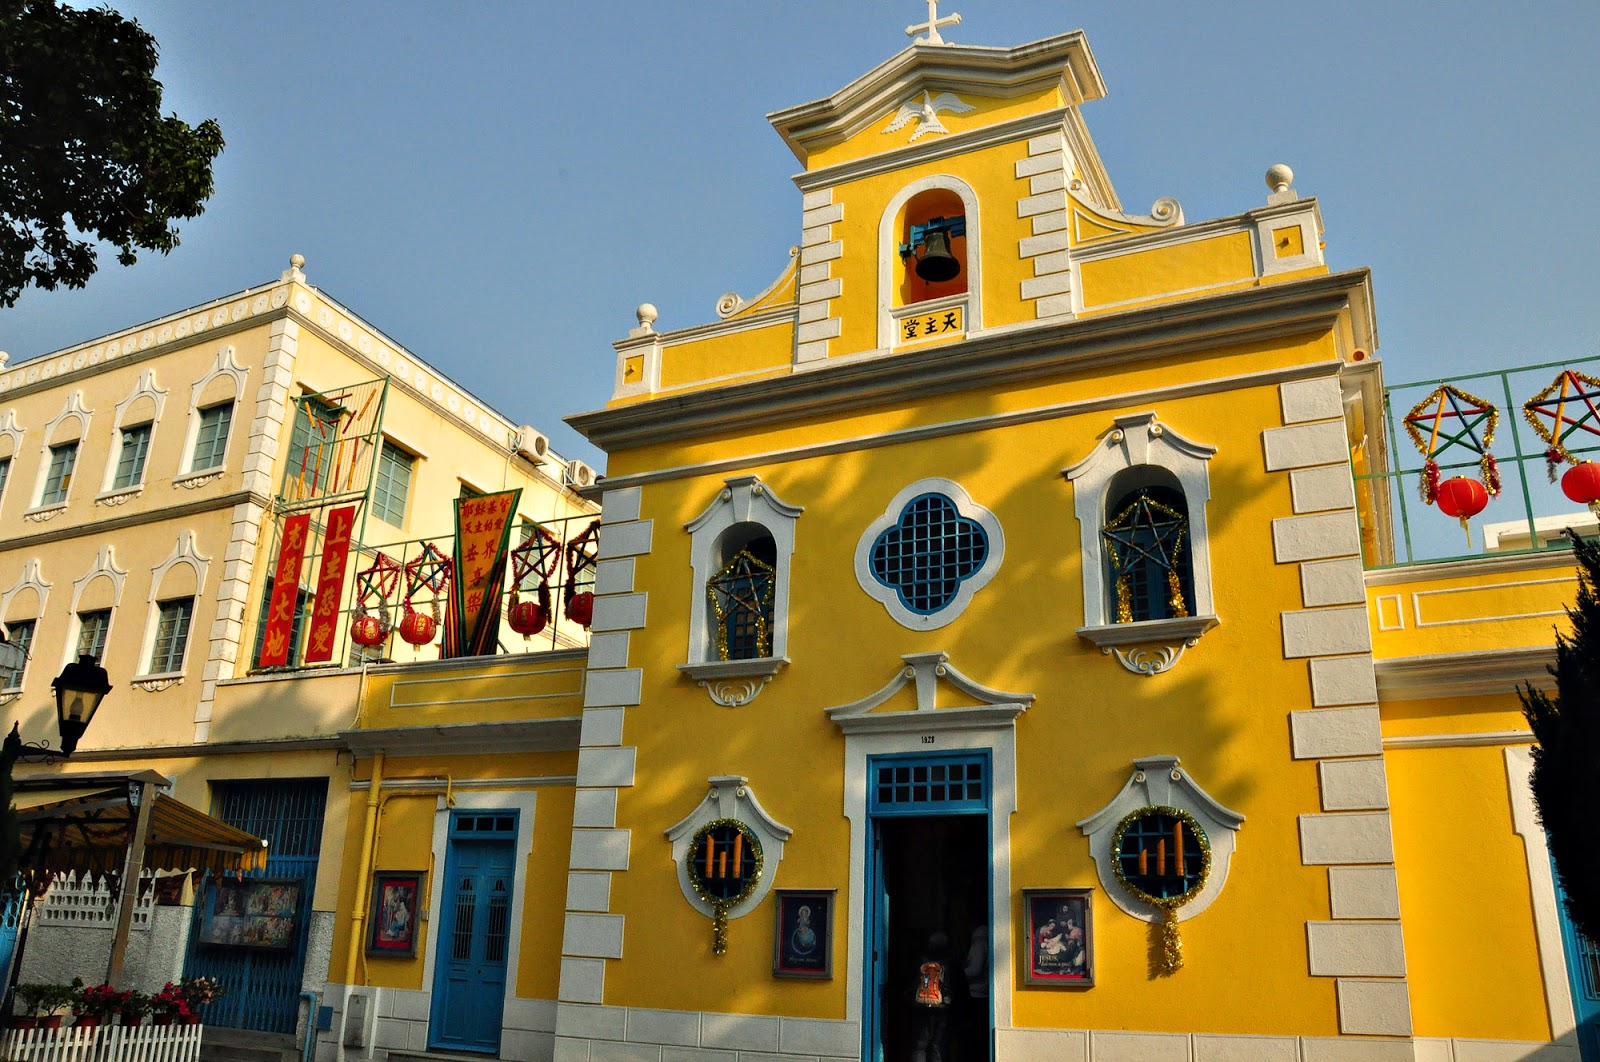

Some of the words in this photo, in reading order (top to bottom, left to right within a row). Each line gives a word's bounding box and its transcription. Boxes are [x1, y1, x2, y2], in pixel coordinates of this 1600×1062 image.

[311, 515, 347, 653] 上主慈愛
[921, 736, 935, 744] 1928
